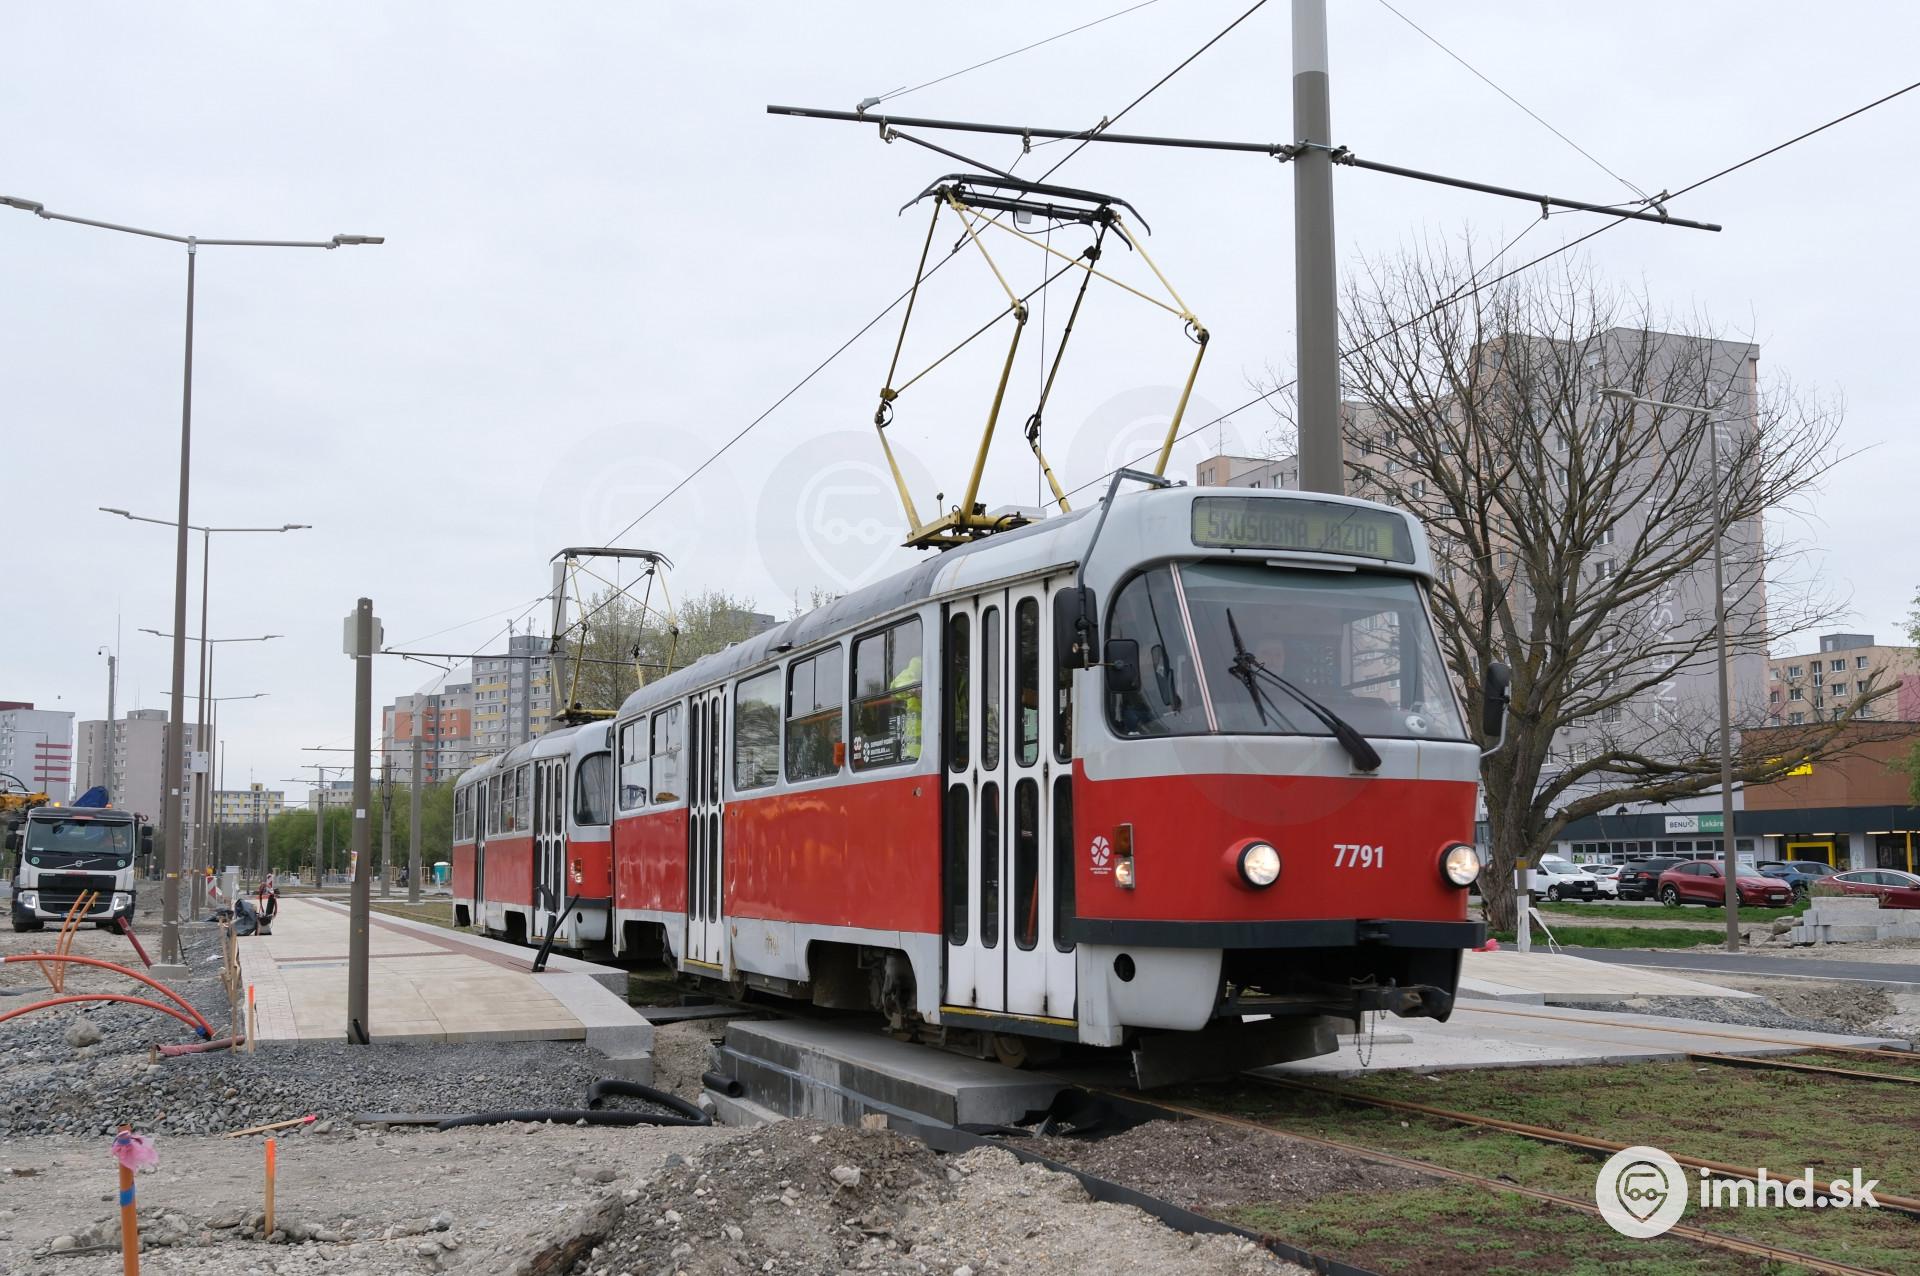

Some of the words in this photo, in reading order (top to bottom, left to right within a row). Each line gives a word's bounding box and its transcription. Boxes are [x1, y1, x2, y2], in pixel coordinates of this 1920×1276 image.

[1207, 510, 1309, 546] SKUSOBNA
[1317, 521, 1377, 552] JAZDA
[1701, 819, 1724, 828] Lekáre
[1334, 844, 1384, 868] 7791
